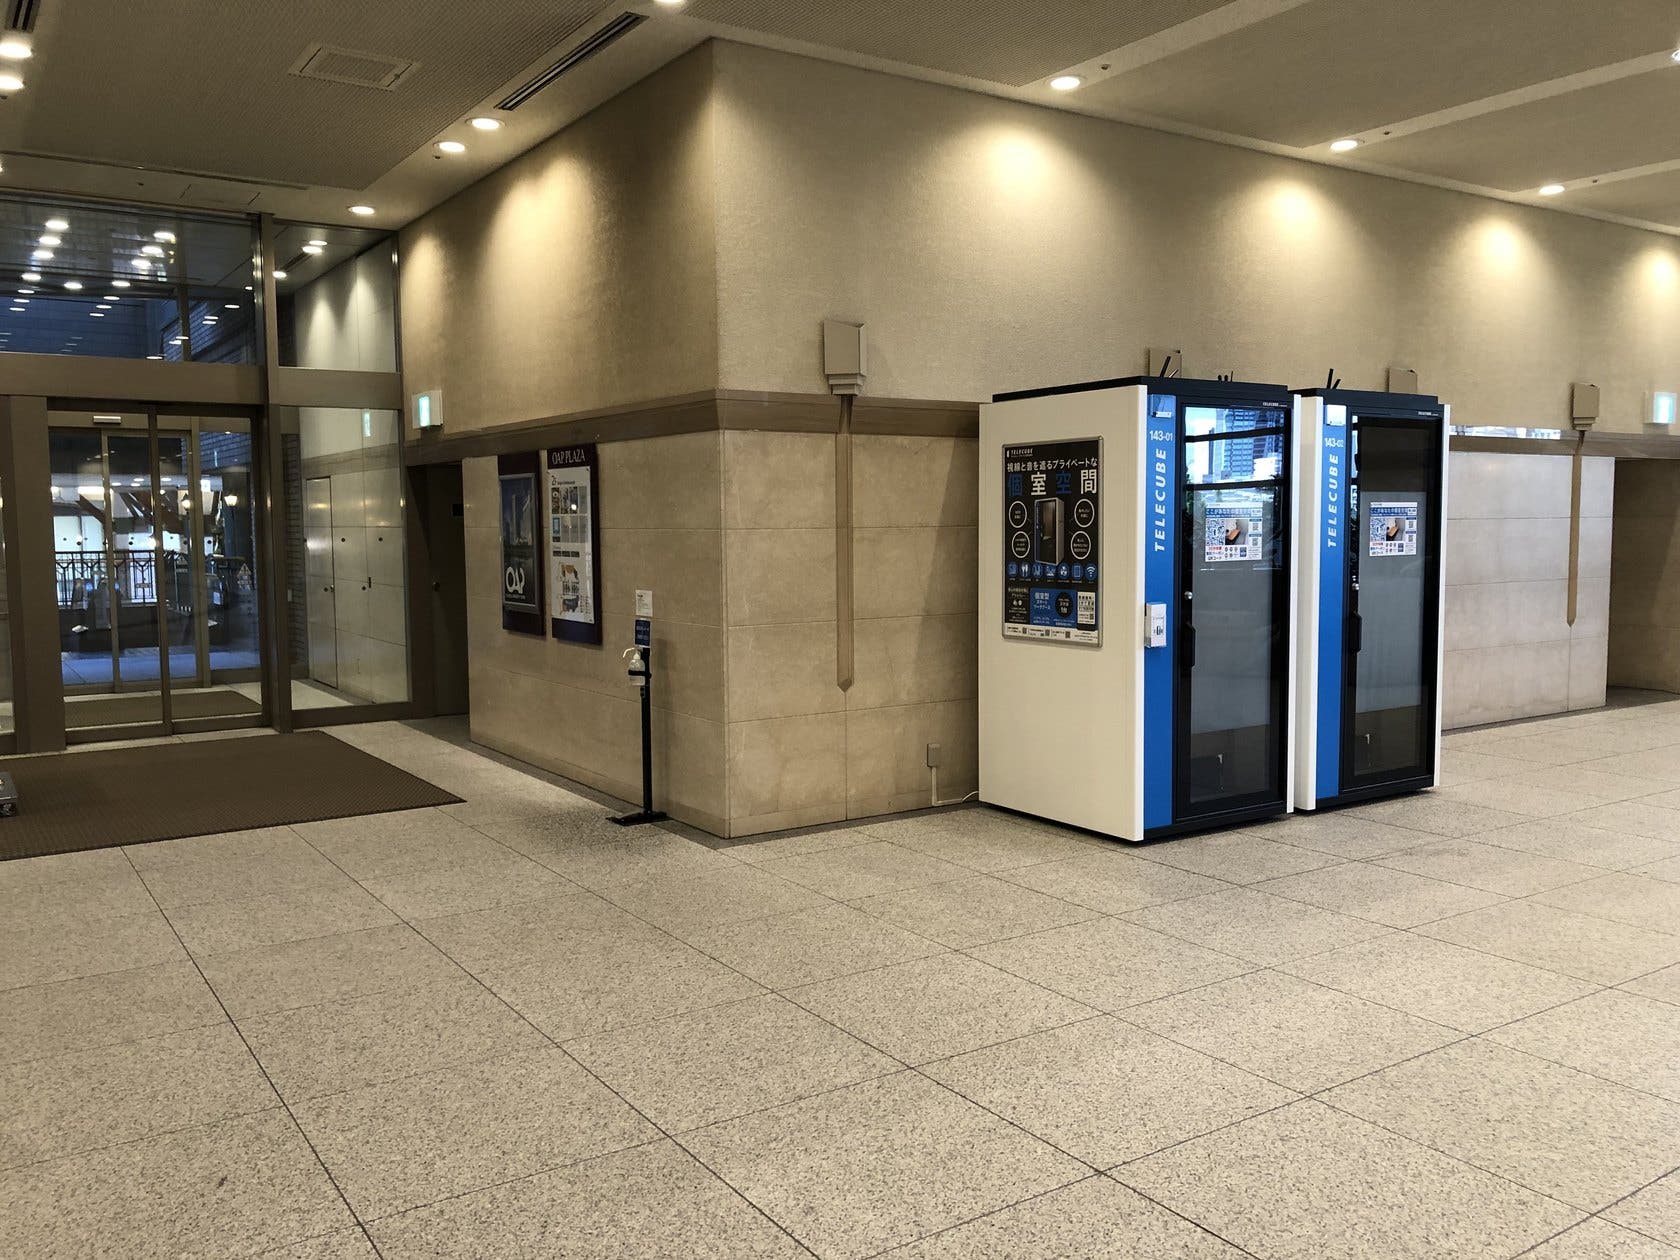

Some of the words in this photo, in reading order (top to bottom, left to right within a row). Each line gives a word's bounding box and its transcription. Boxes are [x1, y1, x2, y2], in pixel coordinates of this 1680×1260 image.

[552, 451, 564, 465] OAP
[565, 449, 586, 463] PLAZA
[1149, 430, 1173, 442] 143-01
[1154, 448, 1167, 552] TELECUBE
[1327, 454, 1339, 548] TELECUBE
